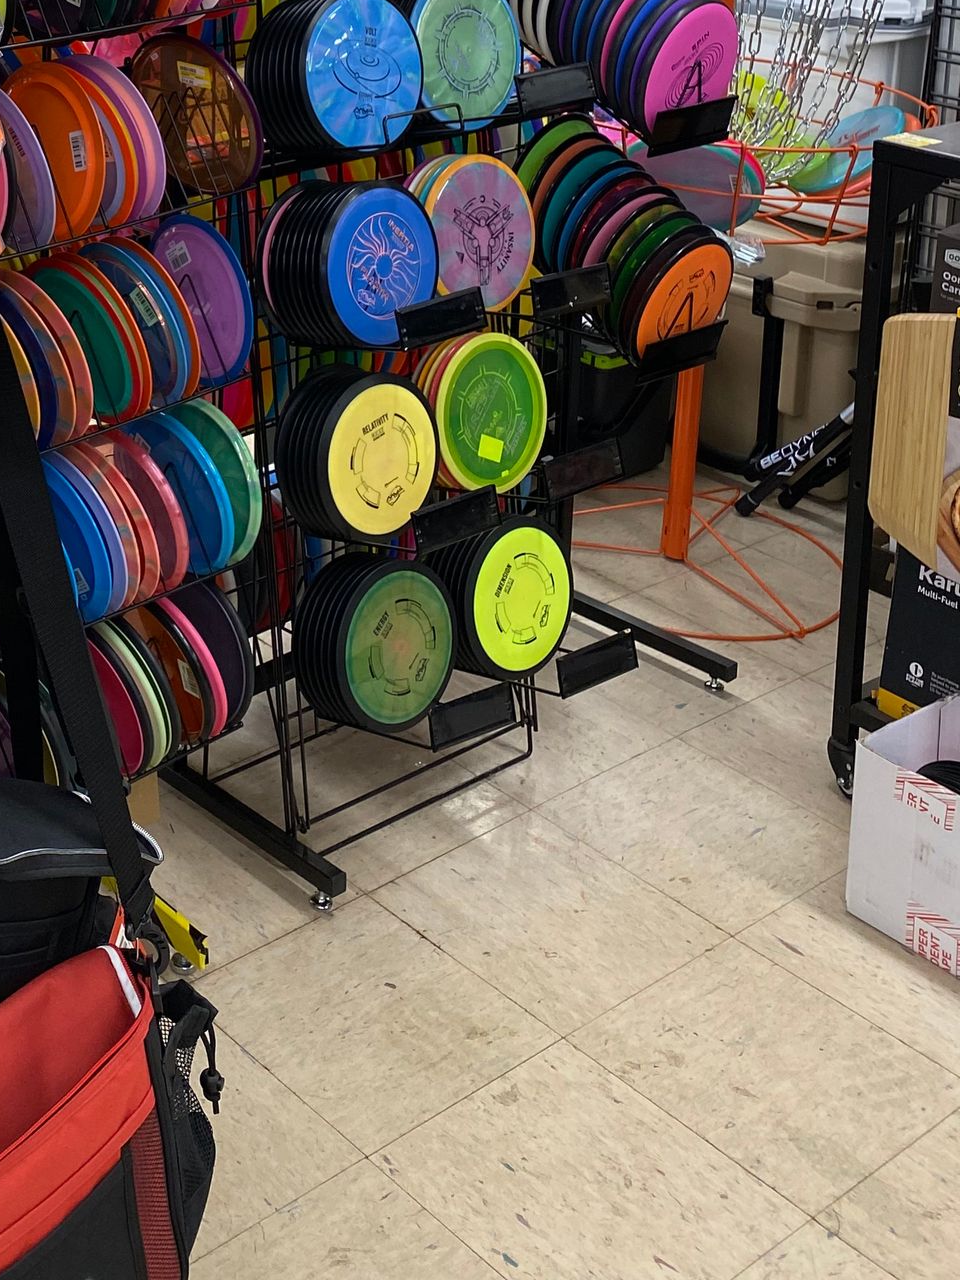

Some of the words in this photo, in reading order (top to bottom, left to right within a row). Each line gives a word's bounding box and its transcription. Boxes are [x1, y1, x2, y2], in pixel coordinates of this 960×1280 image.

[364, 26, 377, 37] VOLT
[496, 231, 515, 274] INSANITY
[362, 412, 389, 436] RELATIVITY
[494, 563, 512, 598] DIMENSION
[917, 585, 959, 610] Multi-Fuel
[372, 610, 390, 637] ENERGY
